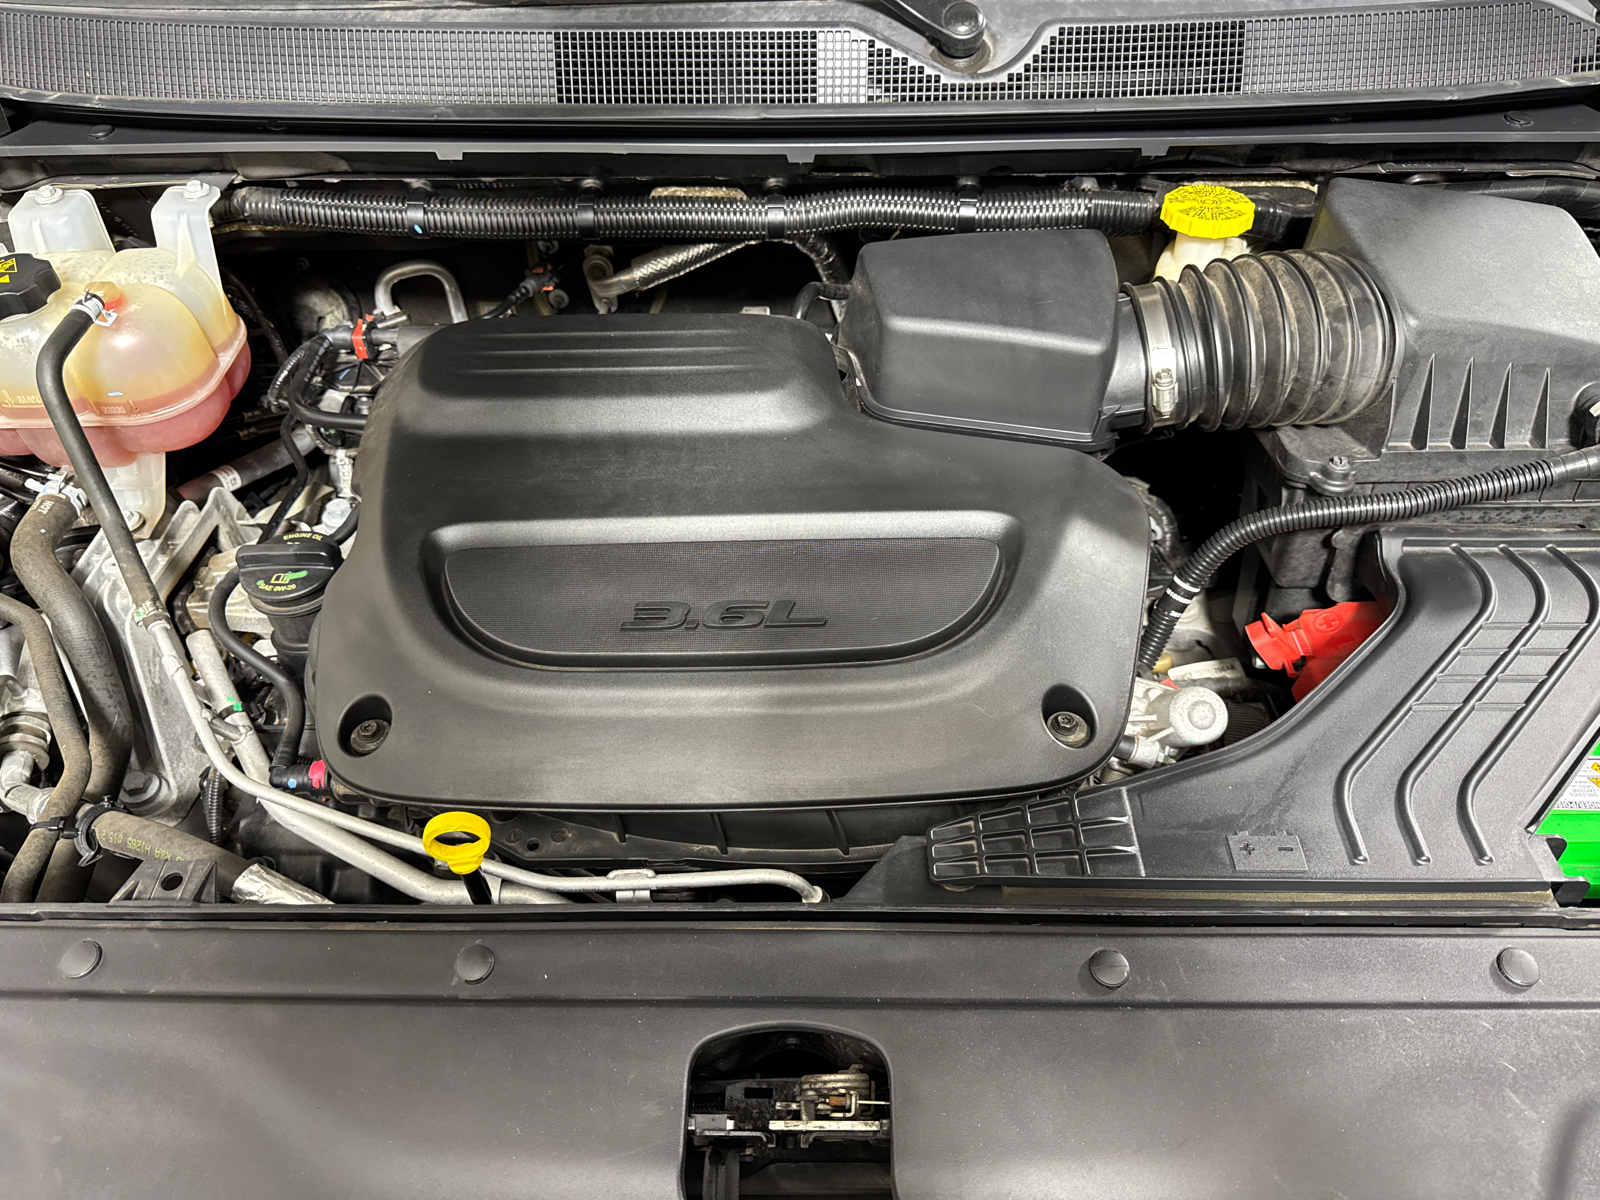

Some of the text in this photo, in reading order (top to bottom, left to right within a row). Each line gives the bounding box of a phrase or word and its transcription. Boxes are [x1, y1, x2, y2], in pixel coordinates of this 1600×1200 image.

[37, 500, 55, 515] HOT
[283, 532, 312, 541] ENGINE
[258, 583, 297, 592] SAE 0W-20
[619, 599, 829, 631] 3.6L
[127, 836, 151, 855] H1265
